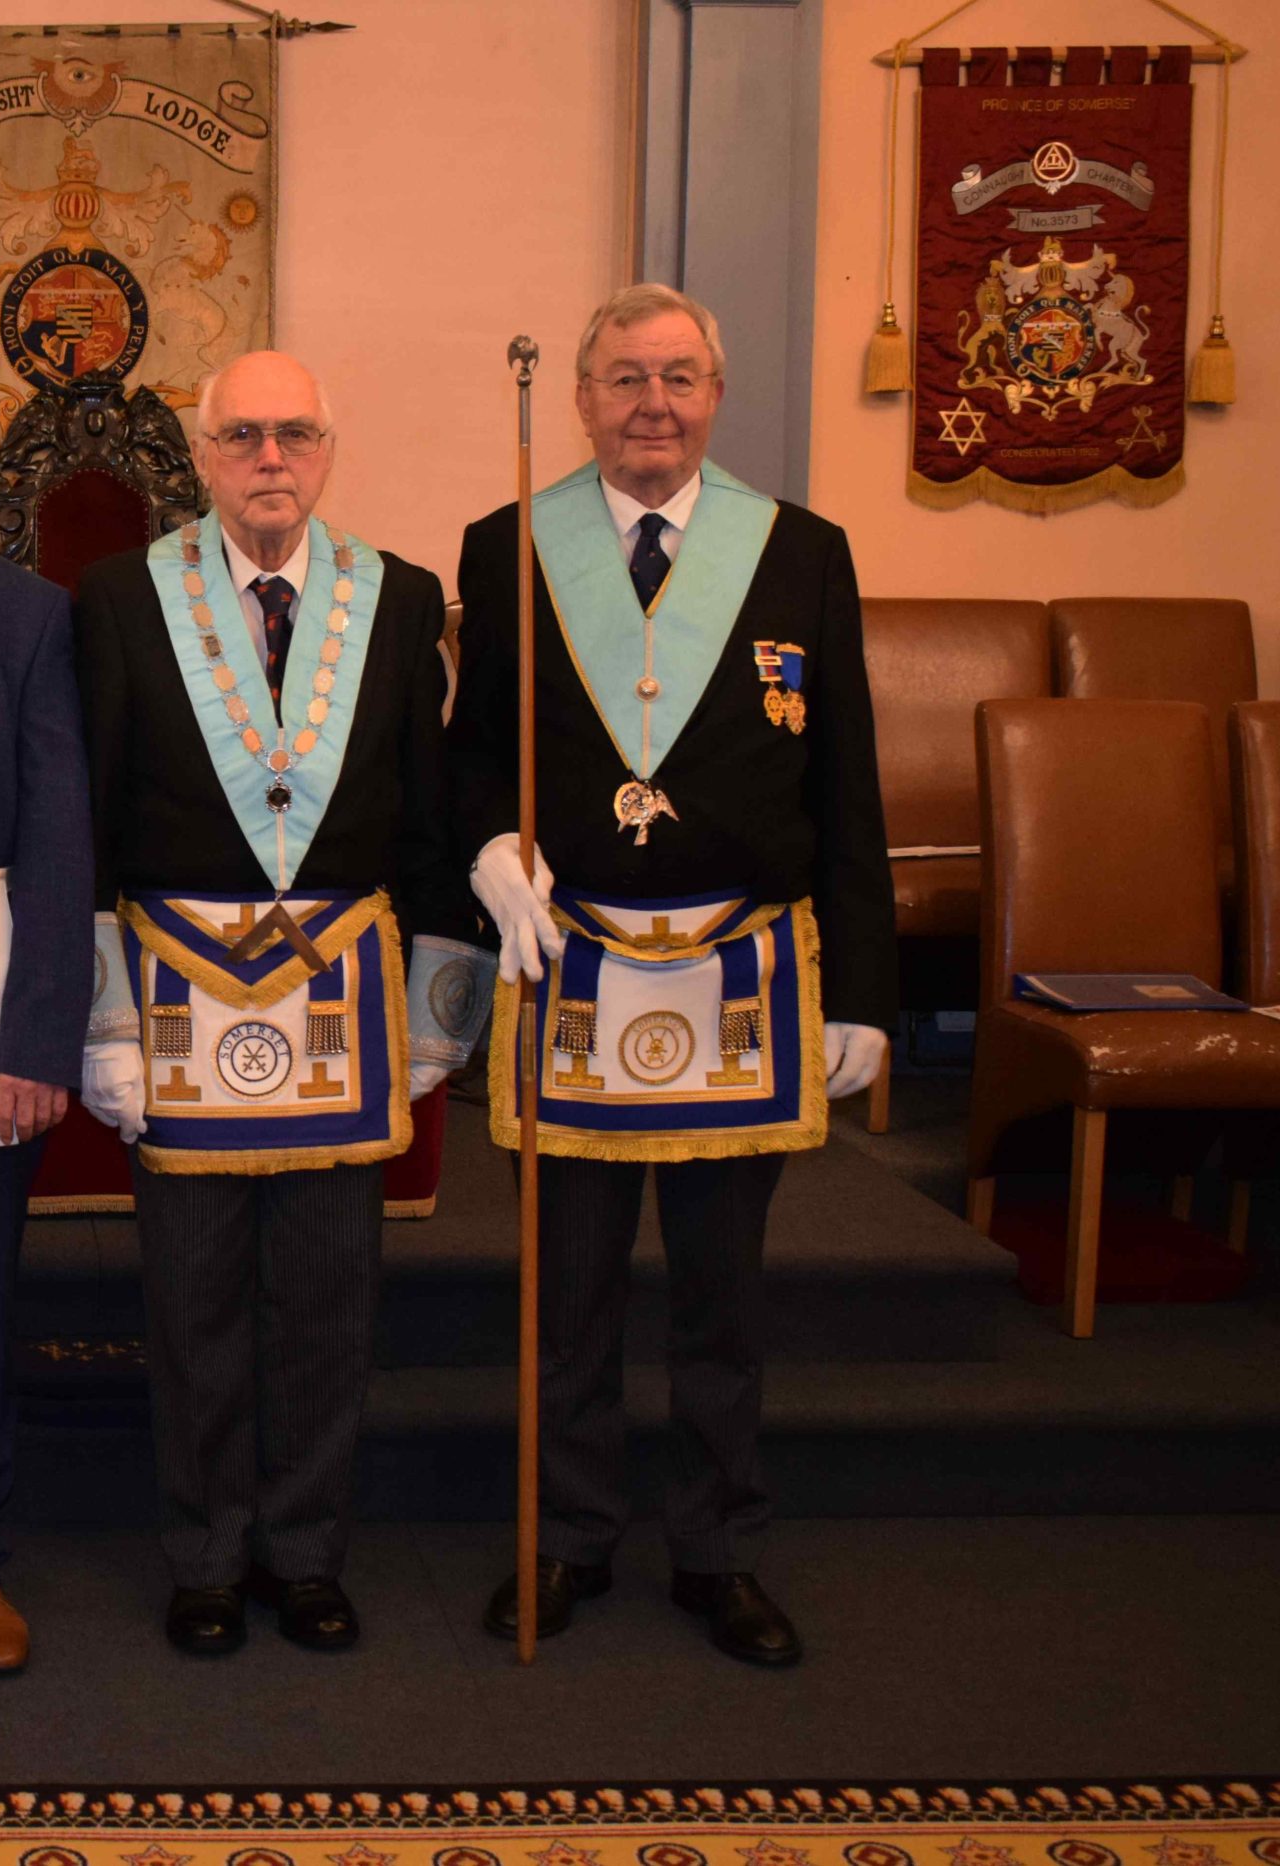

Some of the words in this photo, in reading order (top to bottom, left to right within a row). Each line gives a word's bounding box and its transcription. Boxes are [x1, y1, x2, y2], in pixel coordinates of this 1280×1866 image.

[144, 91, 232, 155] LODGE
[982, 98, 1042, 112] PRONCE
[1046, 98, 1064, 112] OF
[1067, 97, 1137, 112] SOMERSET
[53, 250, 91, 263] QUI
[12, 258, 45, 300] SOIT
[102, 259, 135, 296] MAL
[132, 301, 144, 313] Y
[3, 304, 20, 351] HONI
[112, 325, 145, 378] PENSE
[219, 1022, 290, 1060] SOMERSET
